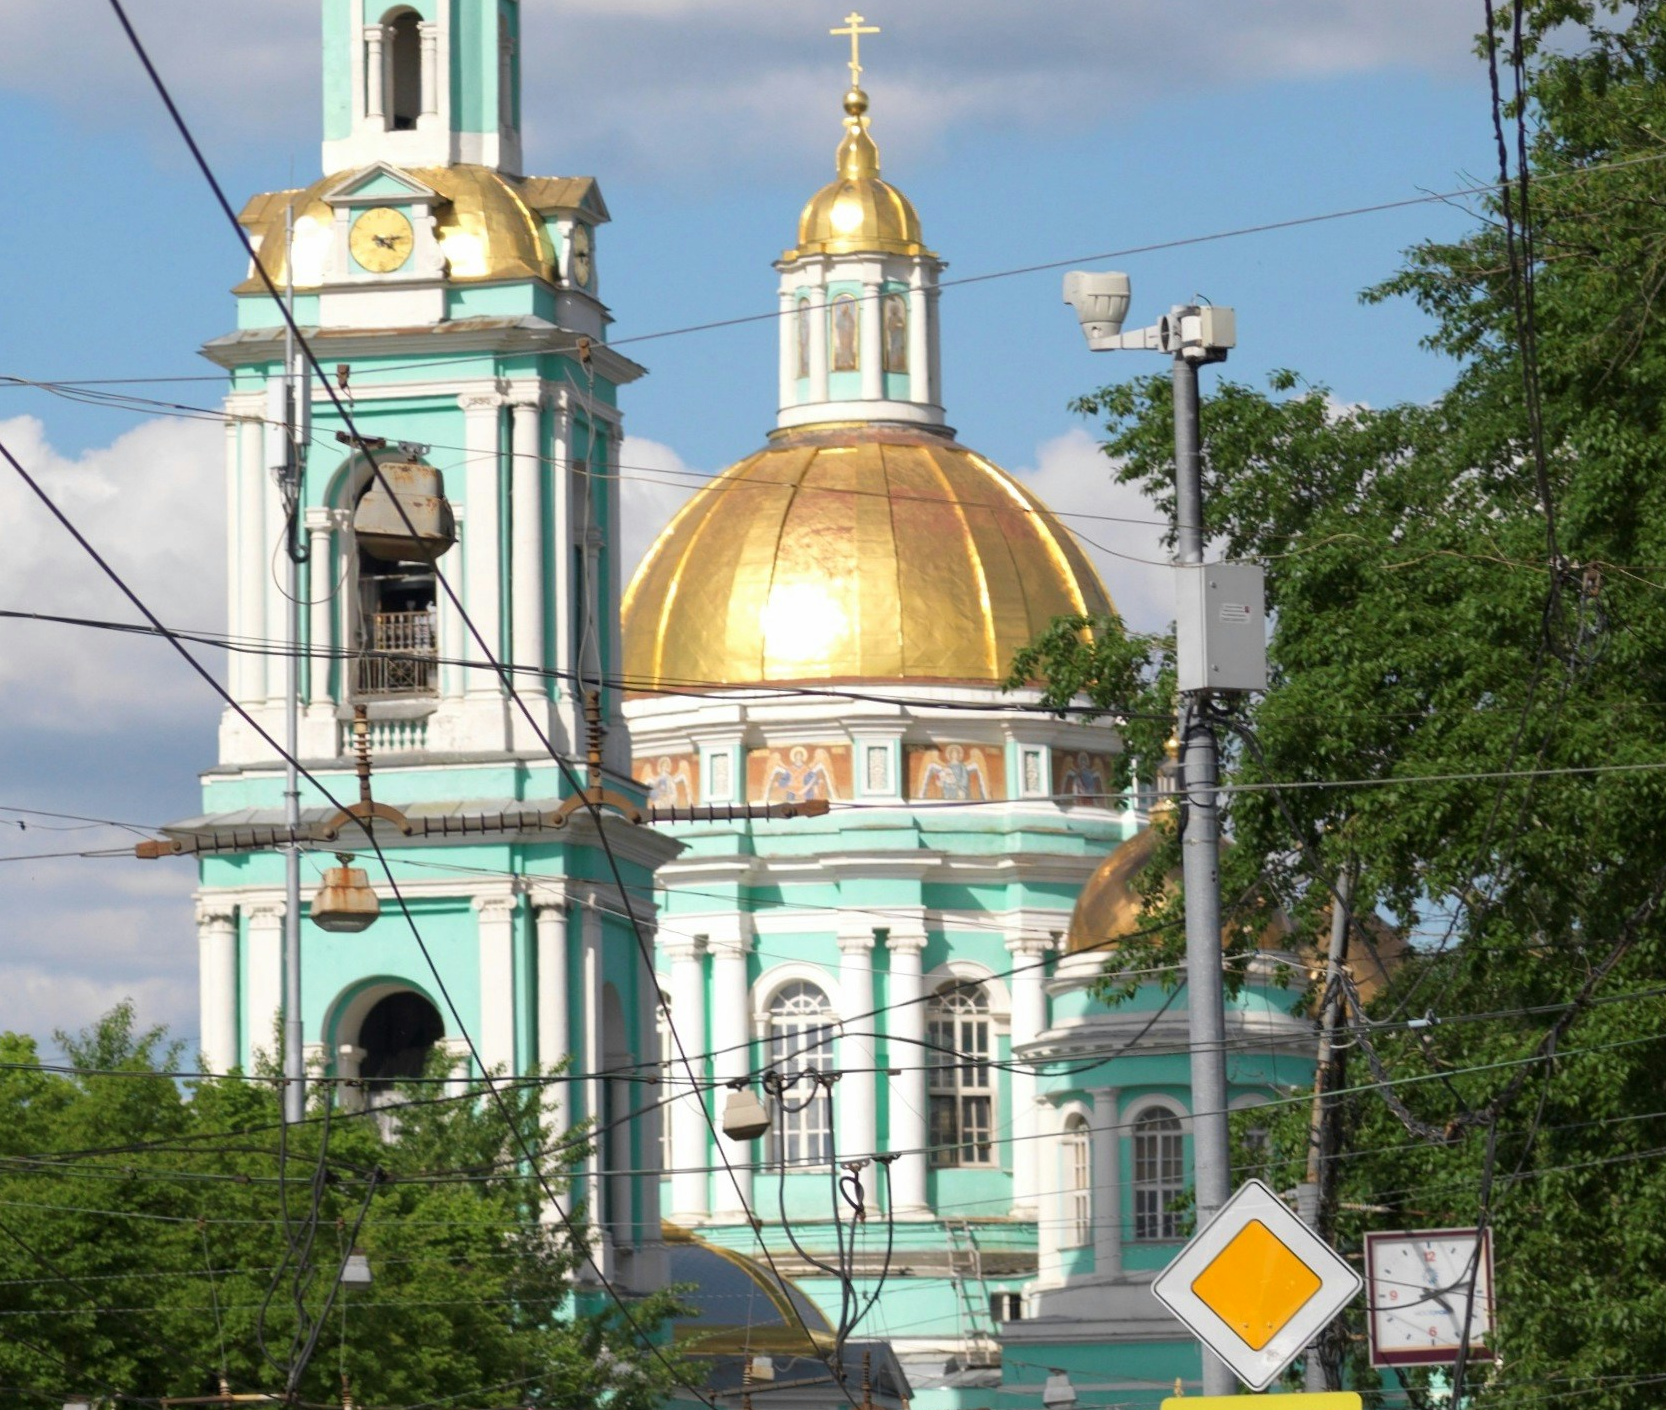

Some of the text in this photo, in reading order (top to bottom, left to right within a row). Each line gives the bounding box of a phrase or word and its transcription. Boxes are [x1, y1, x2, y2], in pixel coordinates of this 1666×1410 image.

[1424, 1251, 1436, 1262] 12
[1390, 1289, 1399, 1301] 9
[1428, 1326, 1438, 1337] 6
